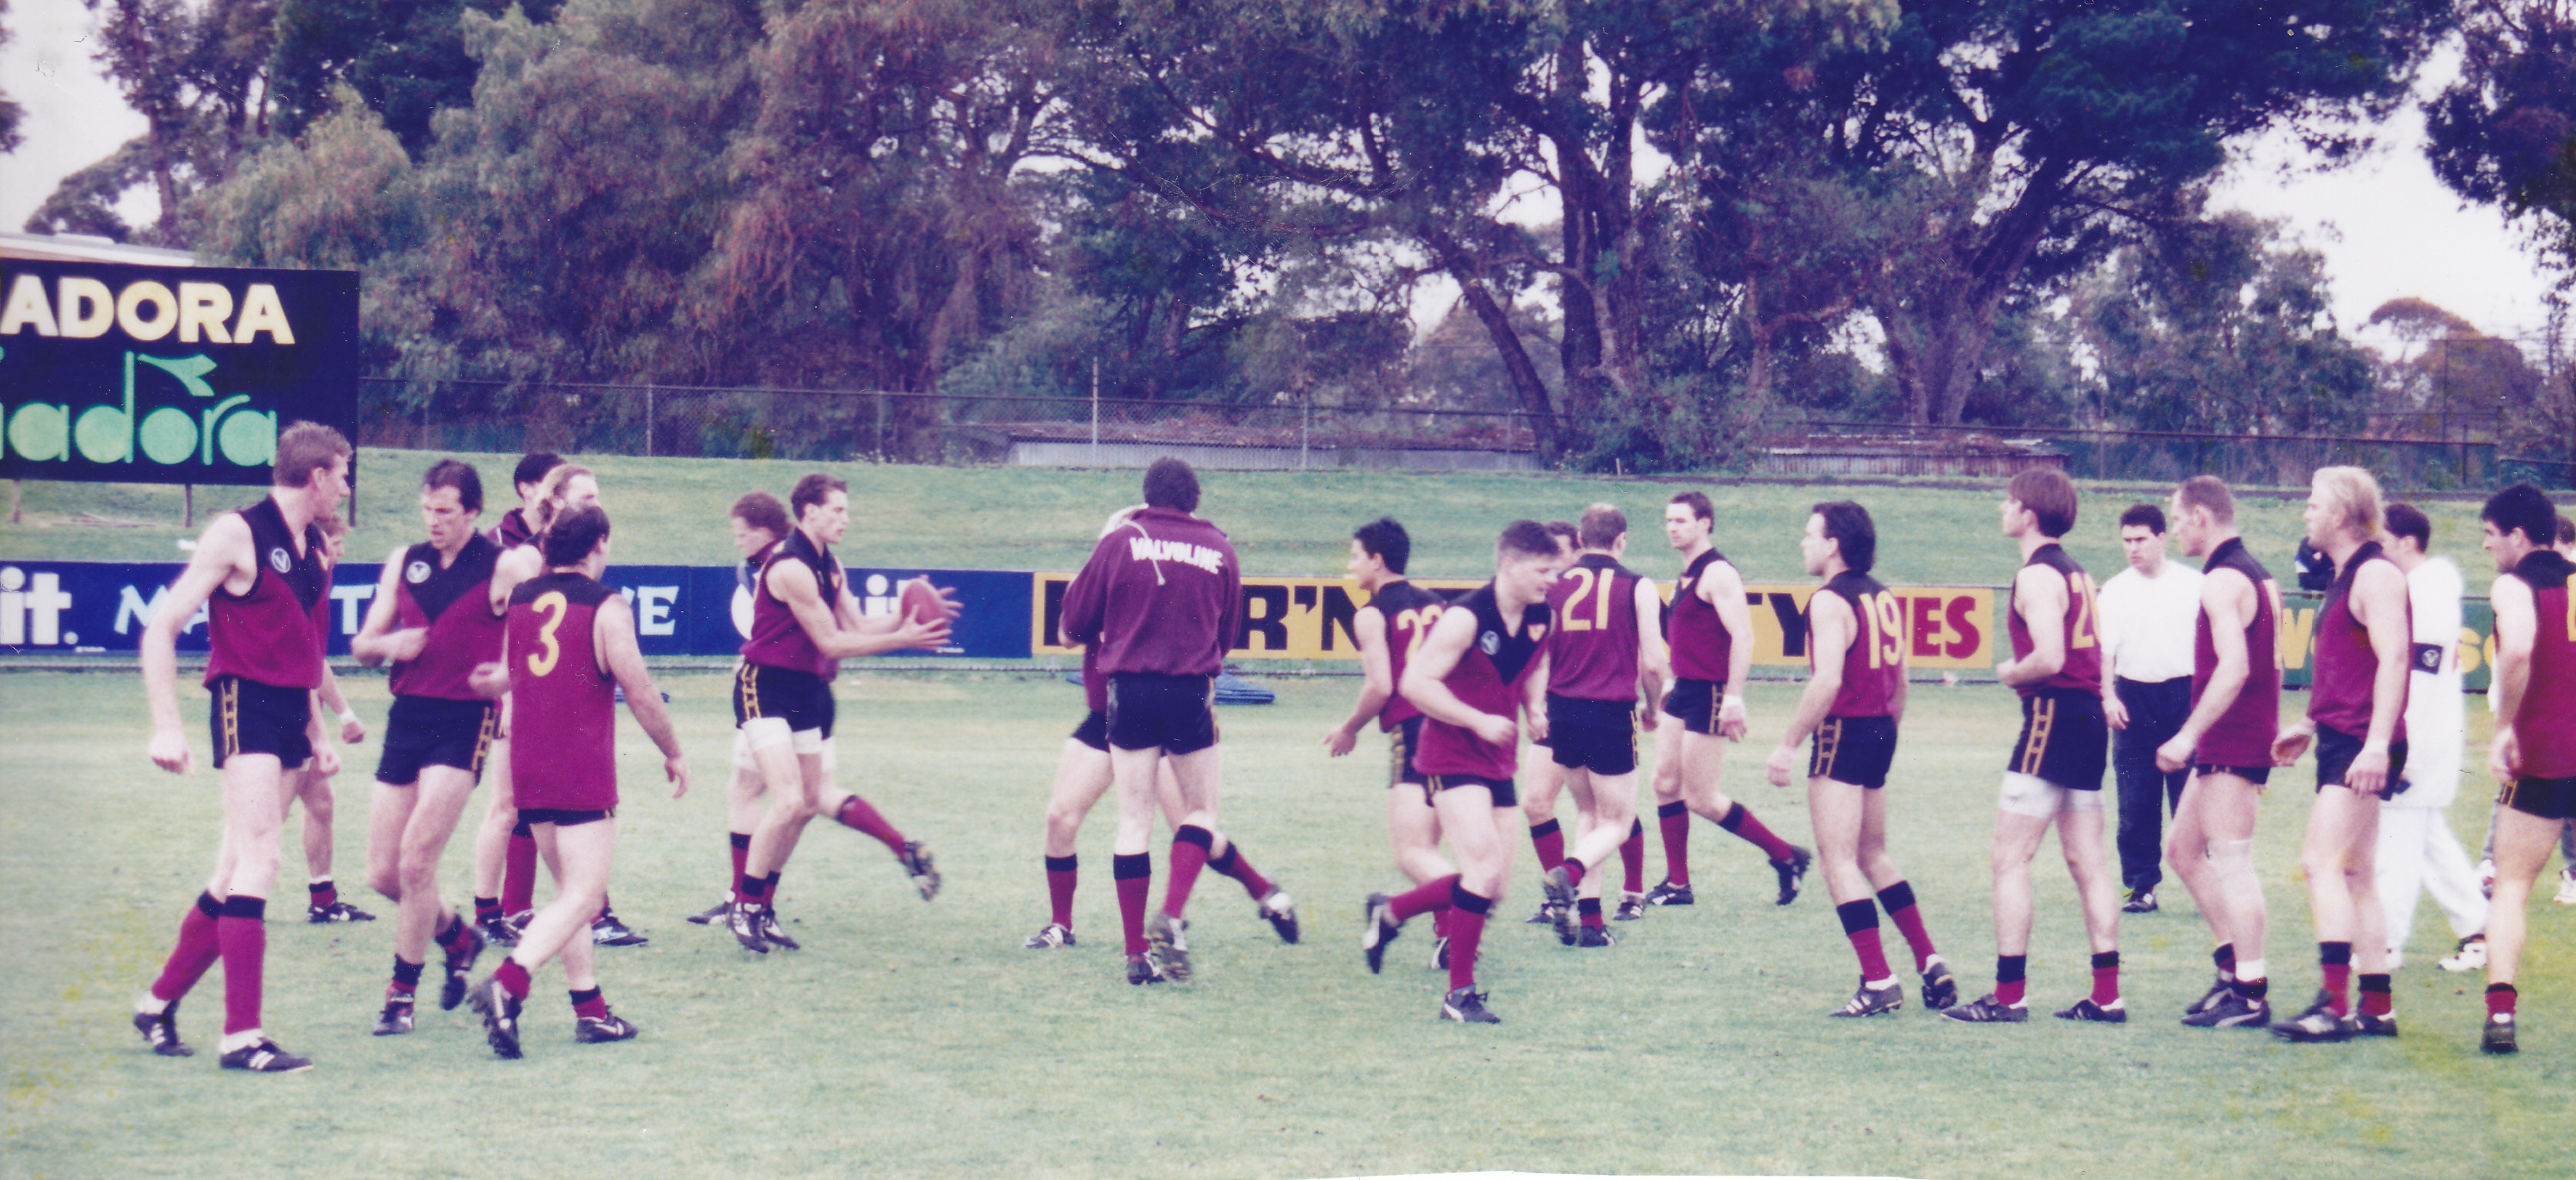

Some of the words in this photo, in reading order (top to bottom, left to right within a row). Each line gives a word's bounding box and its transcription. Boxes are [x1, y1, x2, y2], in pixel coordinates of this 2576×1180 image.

[1129, 536, 1223, 575] VALVOLINE
[528, 591, 567, 676] 3
[1561, 566, 1614, 631] 21
[1859, 590, 1903, 669] 19
